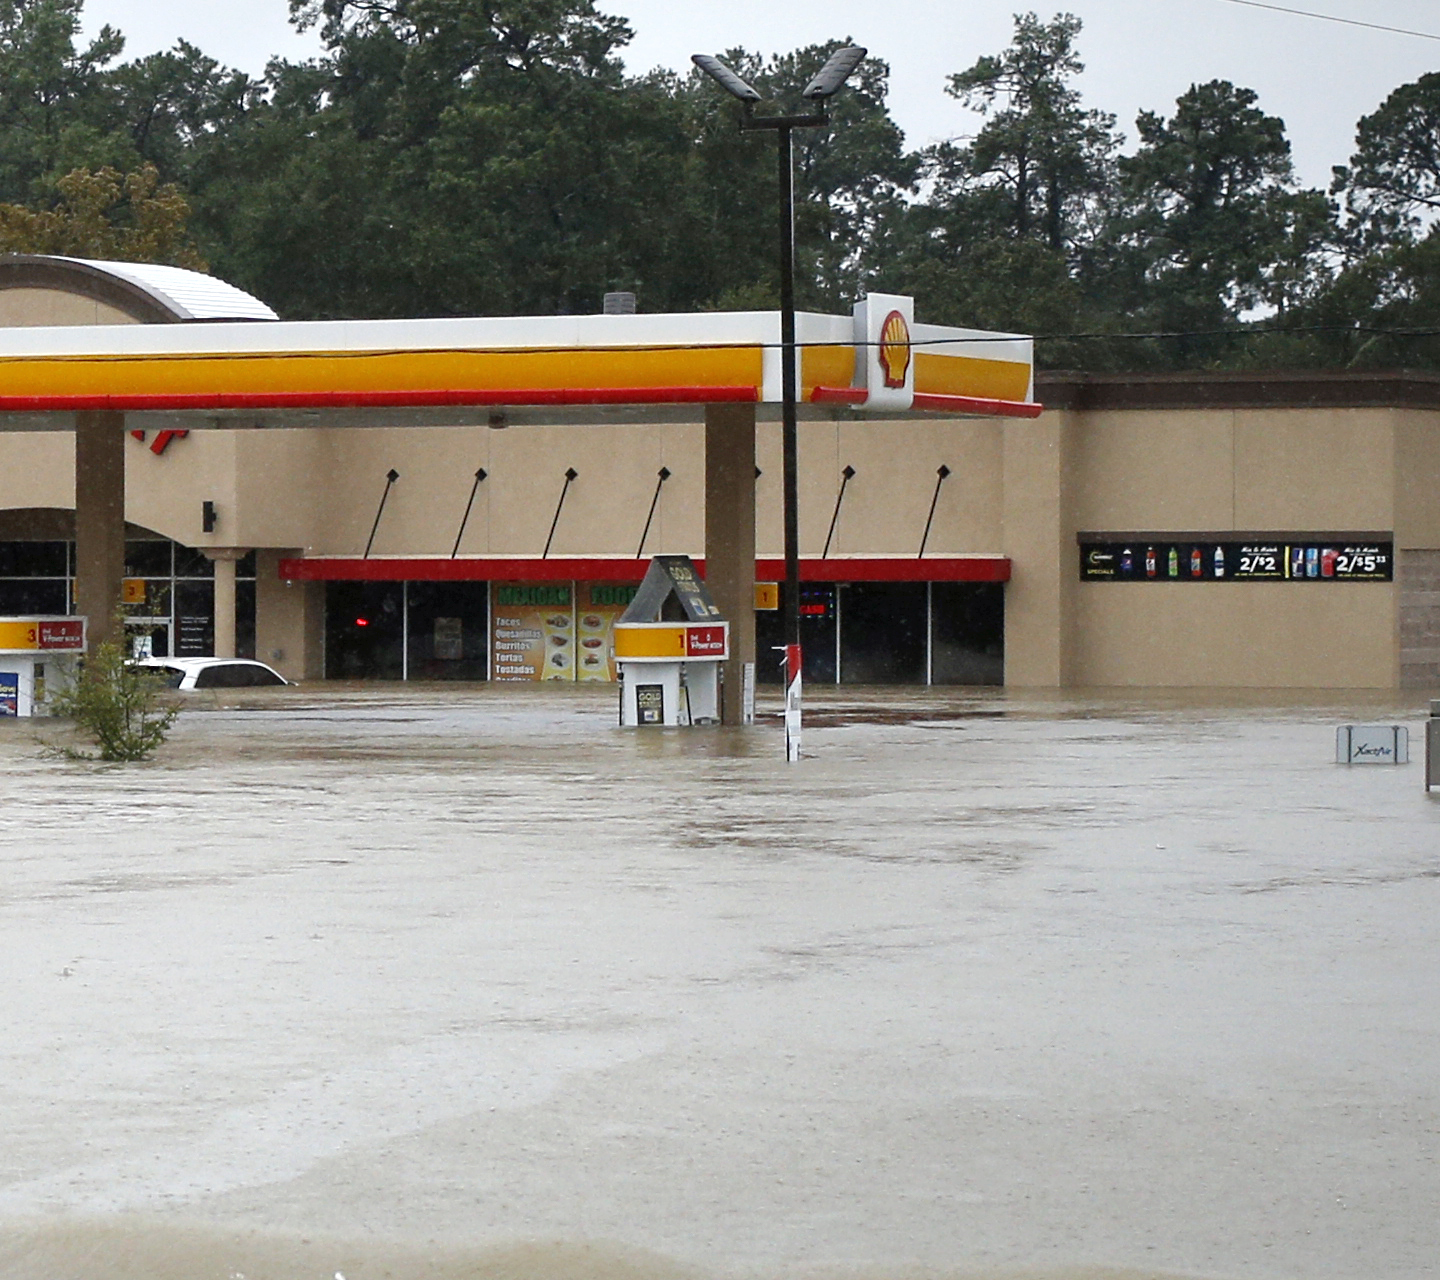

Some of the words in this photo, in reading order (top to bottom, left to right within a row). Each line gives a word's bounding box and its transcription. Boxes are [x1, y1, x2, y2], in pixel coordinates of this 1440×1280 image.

[1240, 556, 1276, 572] 2/$2
[129, 586, 135, 595] 3
[498, 586, 569, 605] MEXICAN
[496, 617, 520, 626] Tacos
[28, 629, 36, 642] 3
[679, 635, 684, 648] 1
[638, 692, 662, 701] GOLD
